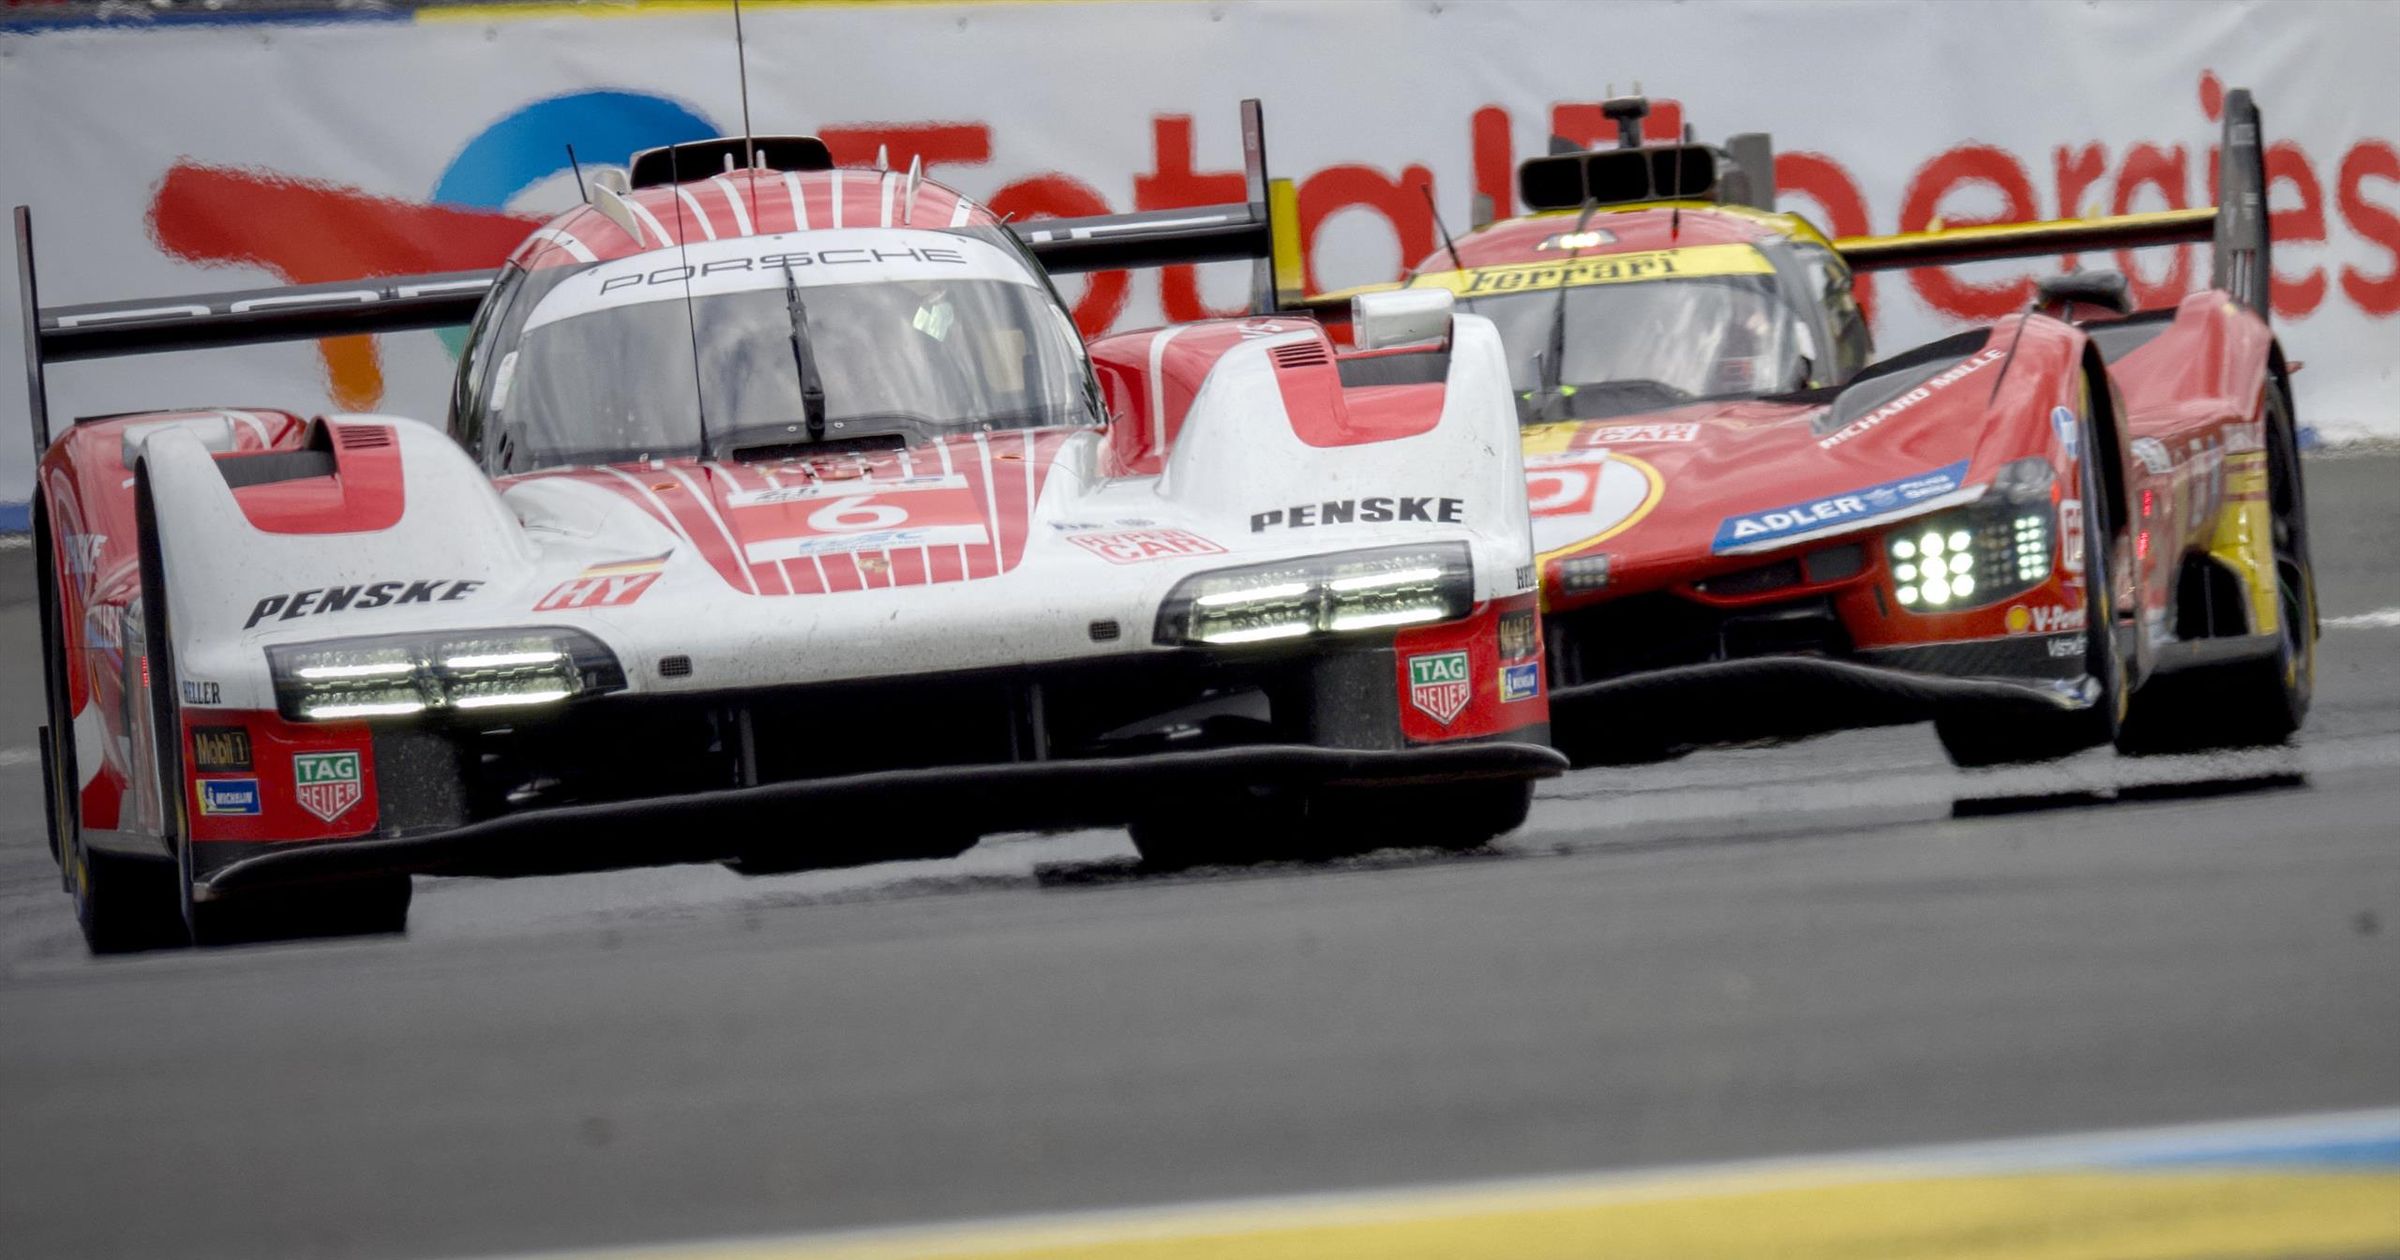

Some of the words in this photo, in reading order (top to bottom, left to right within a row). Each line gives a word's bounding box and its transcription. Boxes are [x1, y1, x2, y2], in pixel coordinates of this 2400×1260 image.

[600, 248, 967, 295] PORSCHE
[1465, 248, 1681, 293] Ferrari
[1818, 386, 1931, 450] RICHARD
[1929, 349, 2006, 389] MILLE
[807, 494, 909, 532] 6
[1251, 497, 1464, 533] PENSKE
[1733, 495, 1867, 539] ADLER
[1100, 537, 1215, 560] CAR
[243, 578, 485, 630] PENSKE
[546, 573, 652, 609] HY
[1415, 658, 1465, 682] TAG
[1416, 684, 1467, 719] HEUER
[195, 732, 233, 764] Mobil
[300, 758, 354, 780] TAG
[300, 784, 357, 817] HEUER
